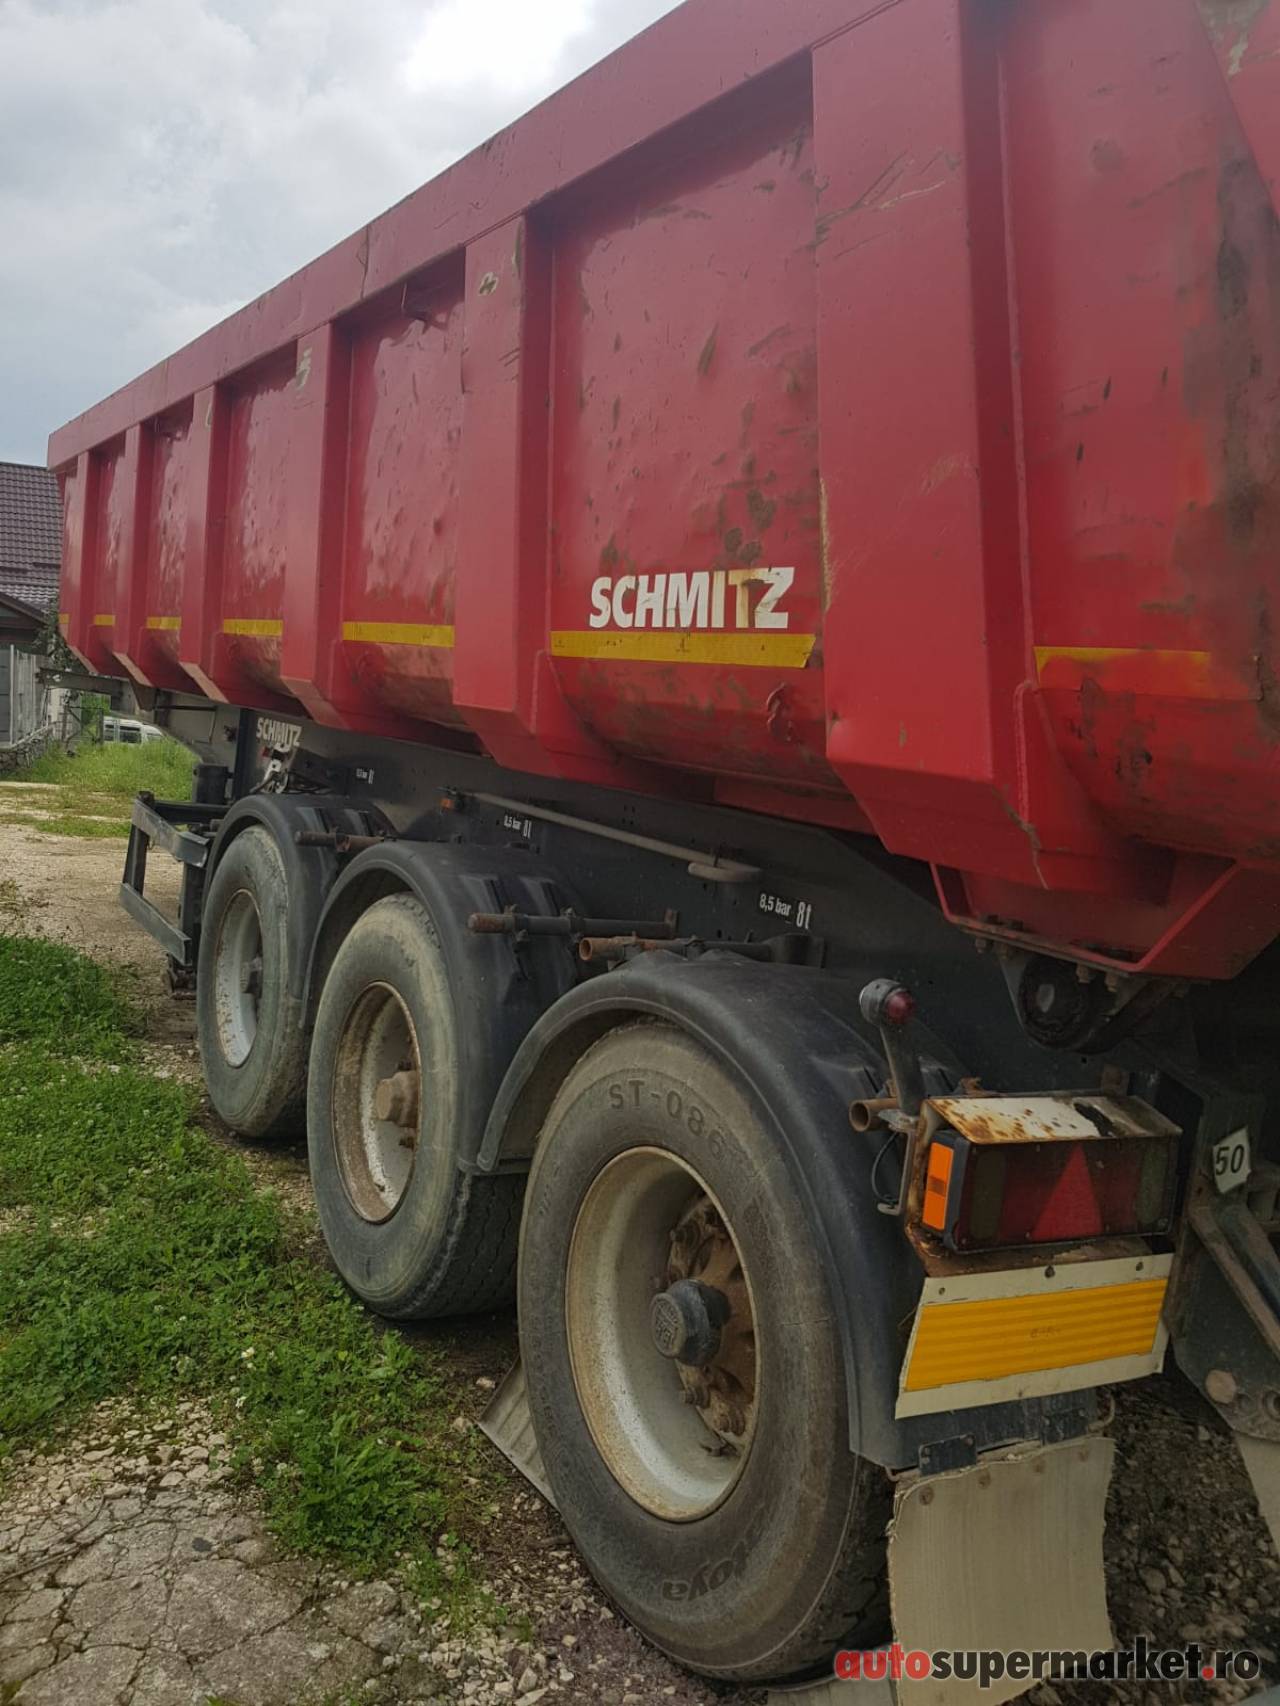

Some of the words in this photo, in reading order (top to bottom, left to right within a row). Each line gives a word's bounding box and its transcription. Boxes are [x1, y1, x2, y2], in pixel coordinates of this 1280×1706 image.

[589, 566, 795, 629] SCHMITZ
[759, 892, 775, 912] 8,5
[775, 897, 792, 917] bar
[608, 1078, 726, 1161] ST-086
[1215, 1143, 1245, 1176] 50
